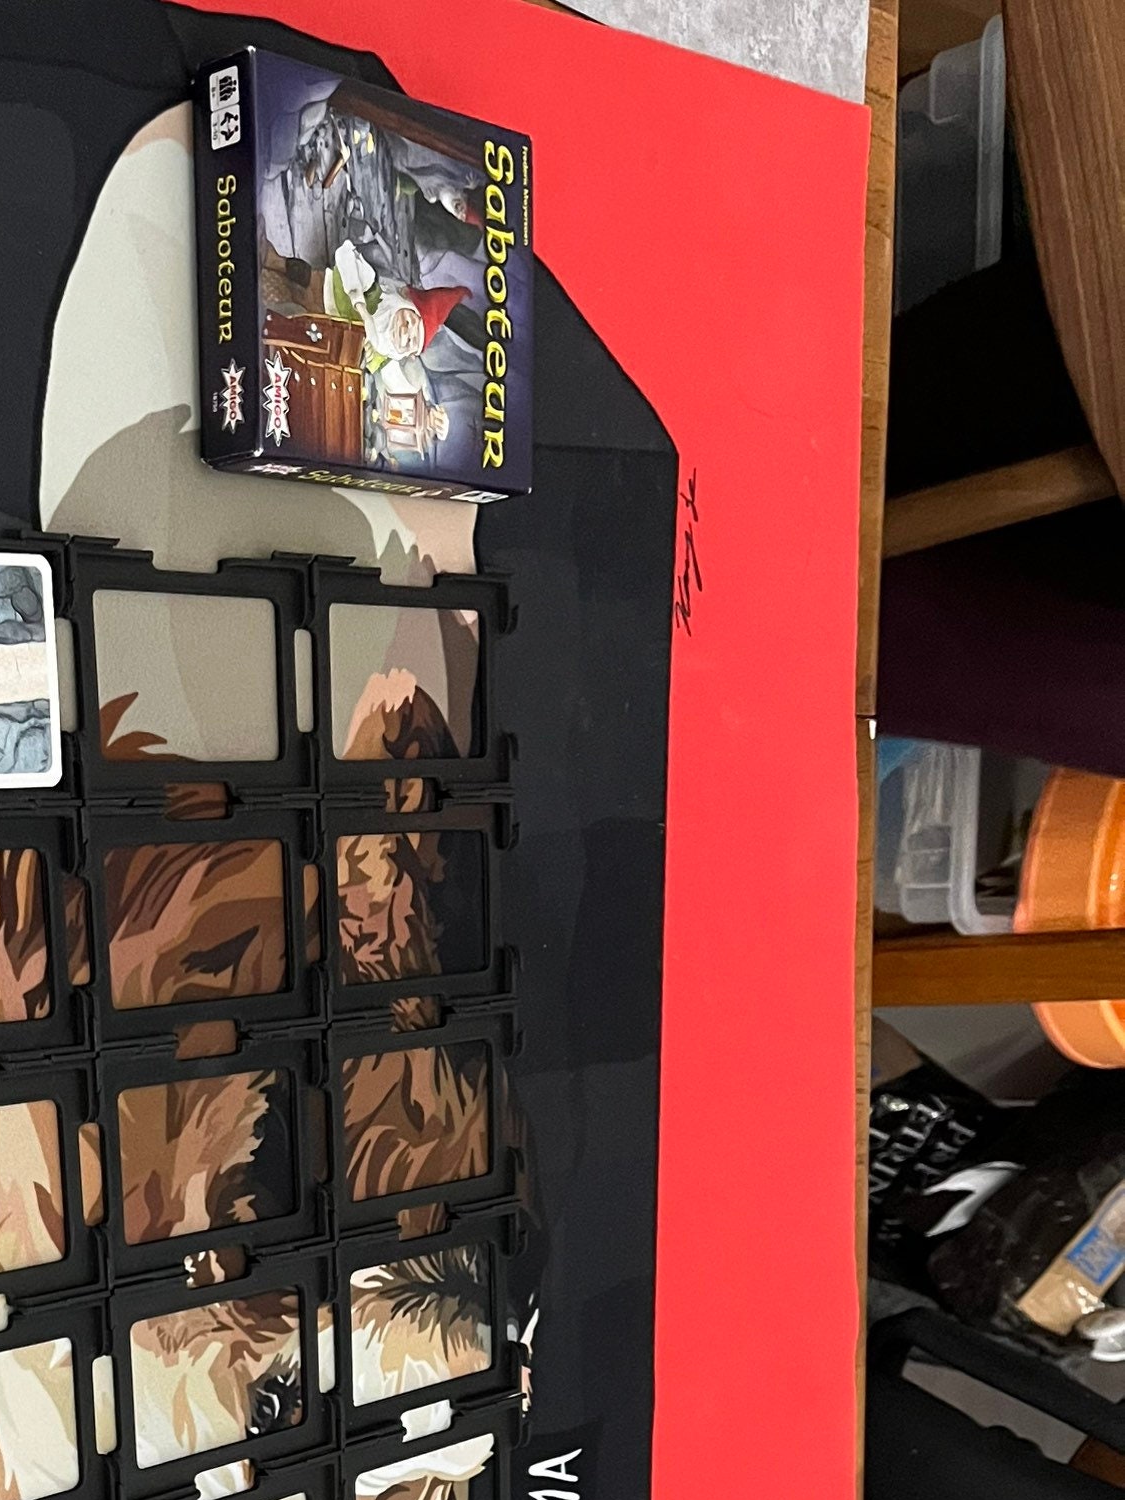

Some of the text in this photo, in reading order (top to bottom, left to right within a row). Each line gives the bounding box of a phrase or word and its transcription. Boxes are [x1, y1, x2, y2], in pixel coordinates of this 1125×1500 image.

[217, 174, 237, 345] Saboteur
[484, 140, 515, 469] Saboteur
[229, 375, 237, 421] AMIGO
[274, 372, 282, 429] AMIGO
